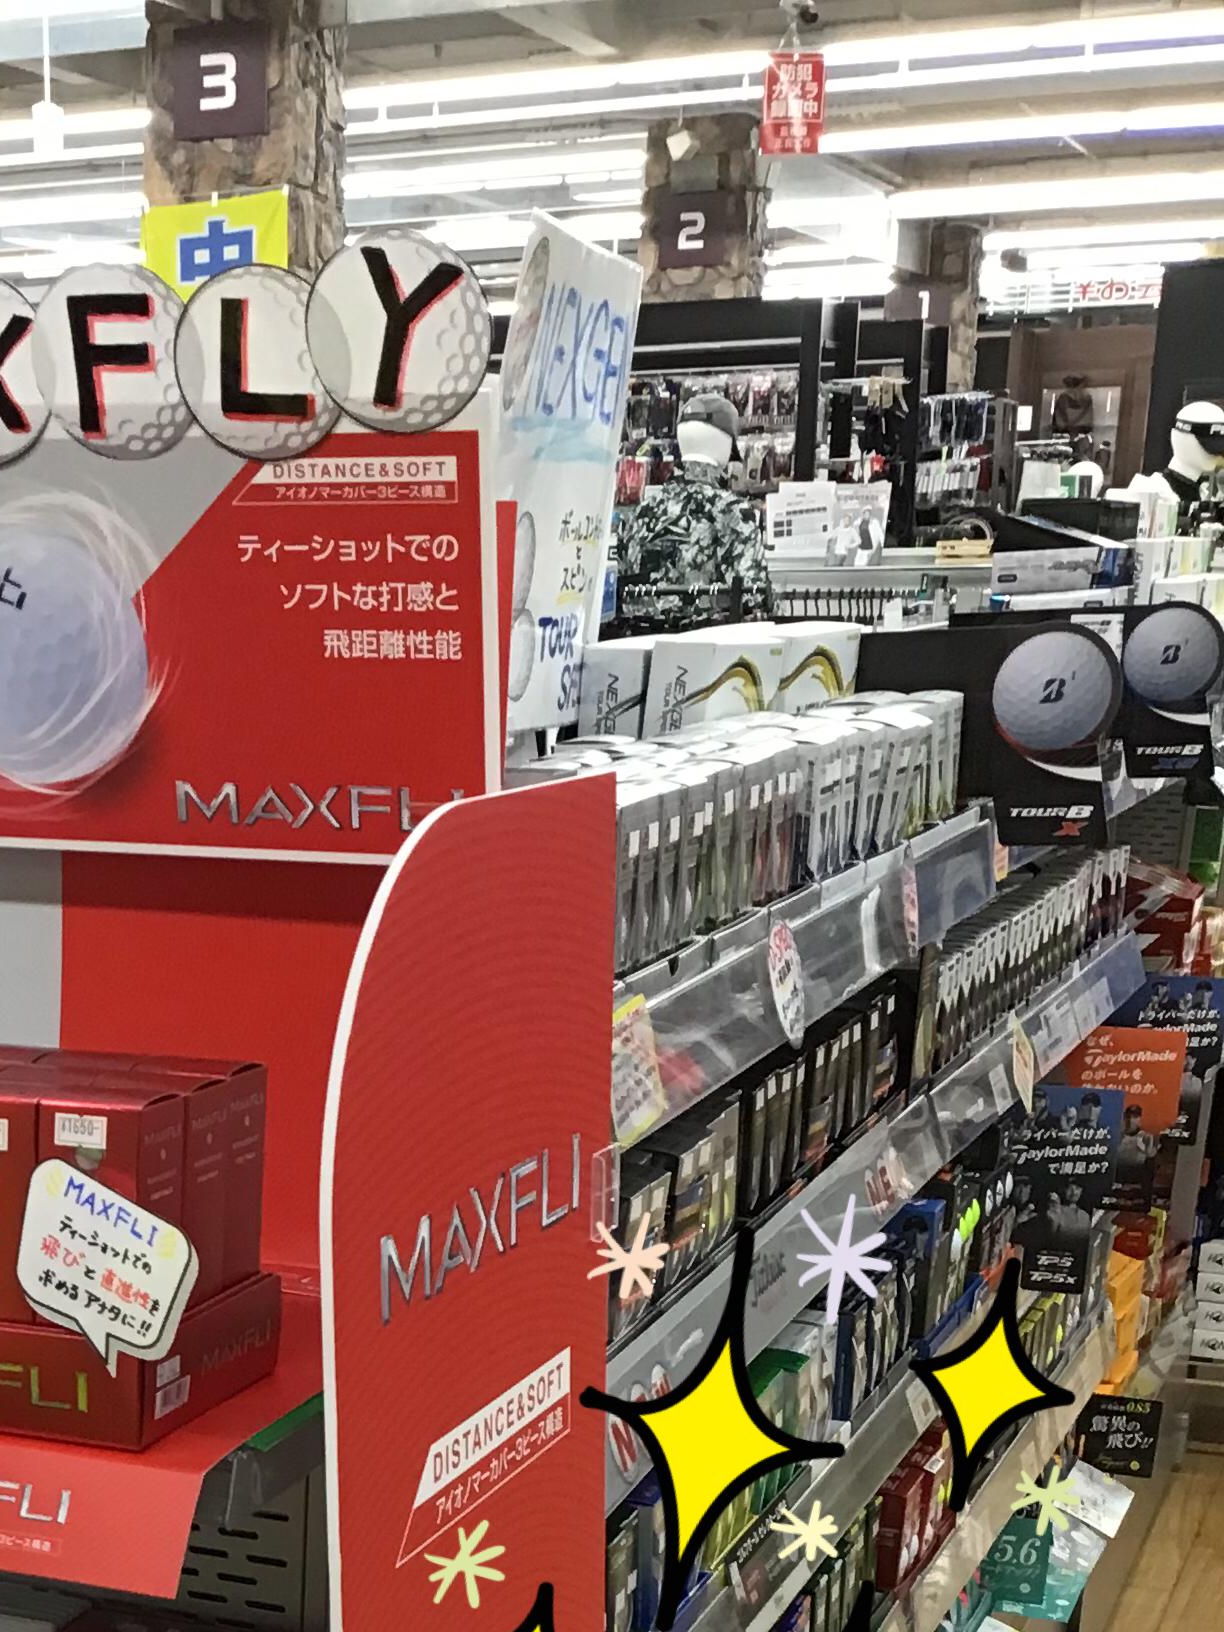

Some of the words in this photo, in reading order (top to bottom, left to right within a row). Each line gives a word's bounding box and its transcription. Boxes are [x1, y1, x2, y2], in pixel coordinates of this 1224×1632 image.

[199, 52, 238, 111] 3
[772, 82, 818, 99] カメラ
[676, 212, 706, 250] 2
[179, 219, 255, 283] 中
[919, 291, 929, 319] 1
[272, 461, 447, 479] DISTANCE&SOFT
[237, 534, 459, 563] ティーショットでの
[280, 582, 459, 612] ソフトな打感と
[324, 629, 463, 661] 飛距離性能
[64, 1176, 159, 1248] MAXFLI
[380, 1132, 581, 1327] MAXFLI
[59, 1215, 152, 1275] ティーショットでの
[433, 1362, 565, 1483] DISTANCE&SOFT
[994, 1535, 1041, 1566] 5.6
